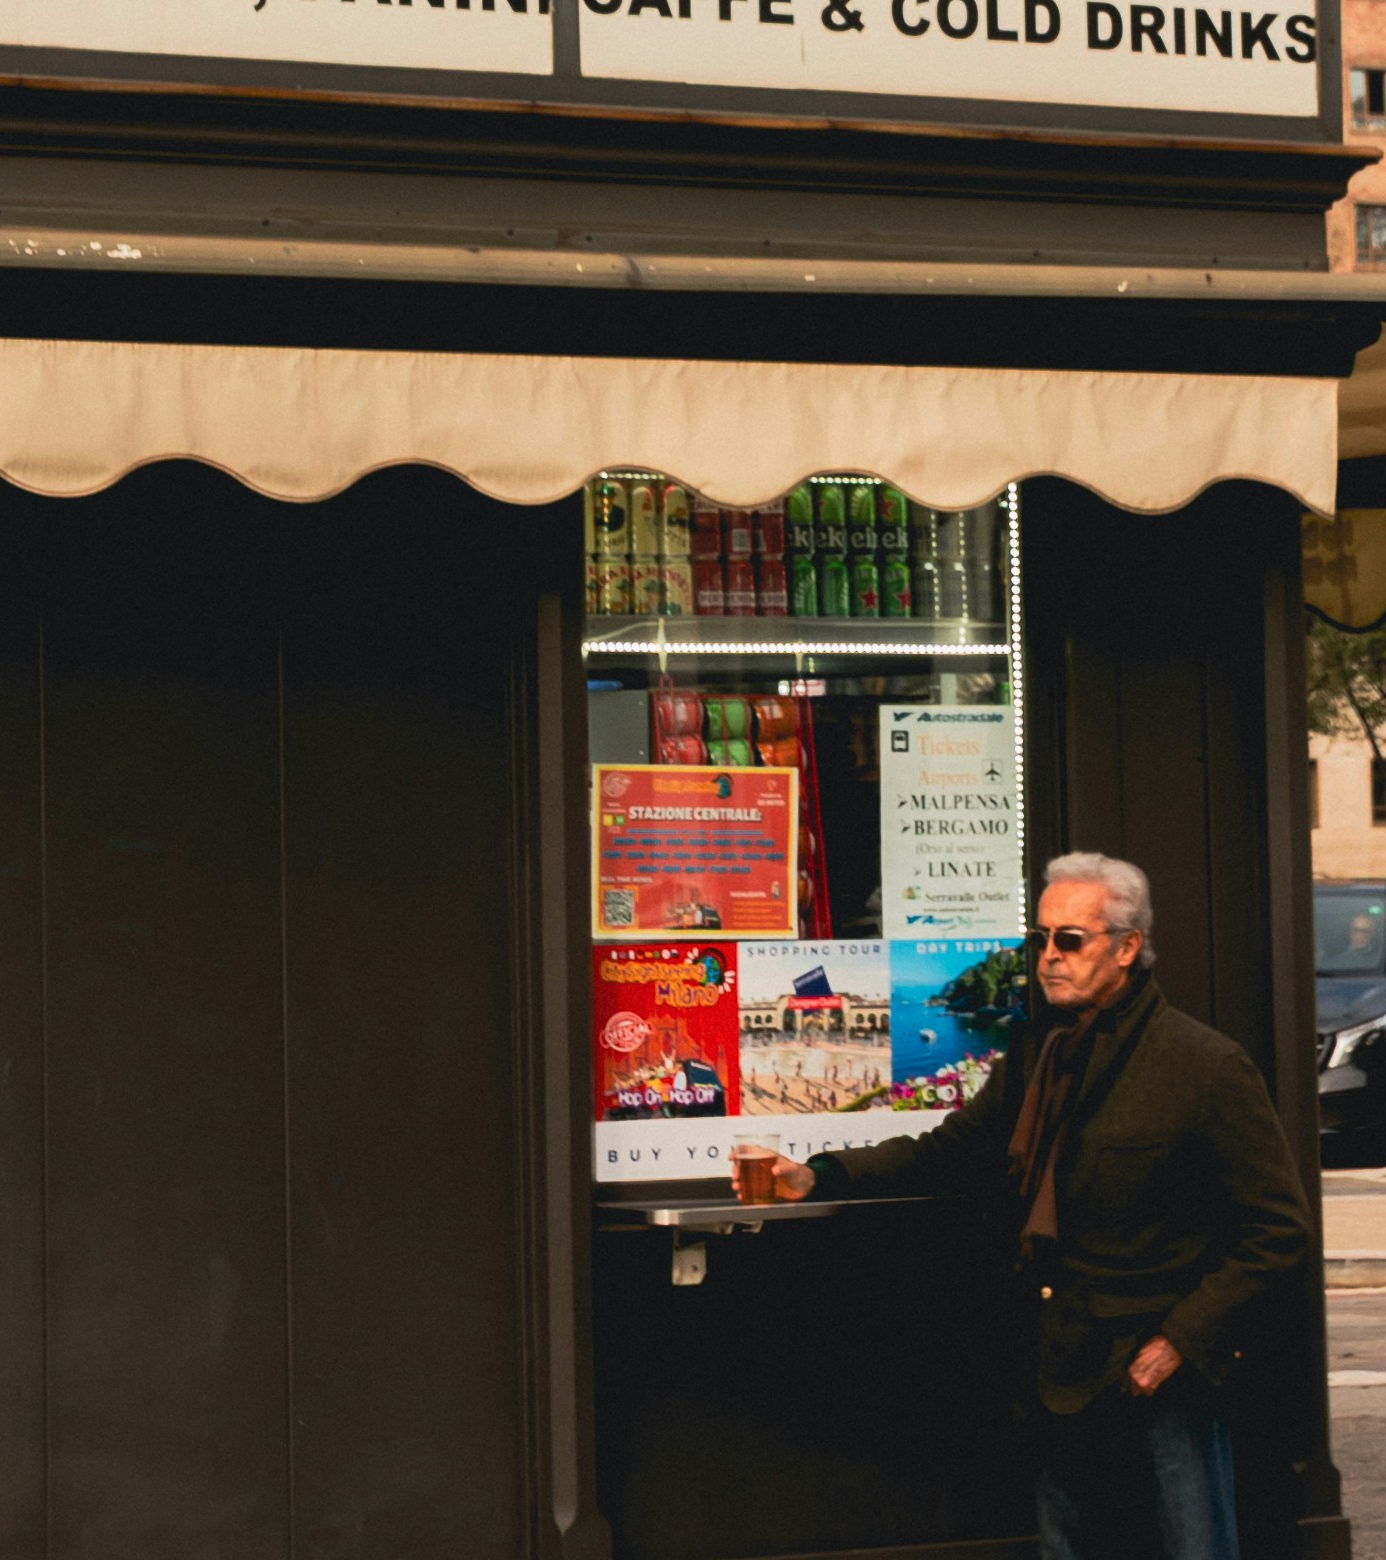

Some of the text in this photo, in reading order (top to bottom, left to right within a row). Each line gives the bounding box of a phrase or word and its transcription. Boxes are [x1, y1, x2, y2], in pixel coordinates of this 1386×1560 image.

[1086, 2, 1317, 64] DRINKS
[917, 712, 1004, 722] Autostradale
[918, 736, 980, 756] Tickets
[911, 795, 1010, 810] MALPENSA
[629, 806, 693, 821] STAZIONE
[914, 819, 1008, 836] BERGAMO
[928, 861, 997, 878] LINATE
[747, 945, 882, 957] SHOPPING TOUR
[916, 942, 1000, 954] DAY TRIPS
[607, 1148, 662, 1164] BUY
